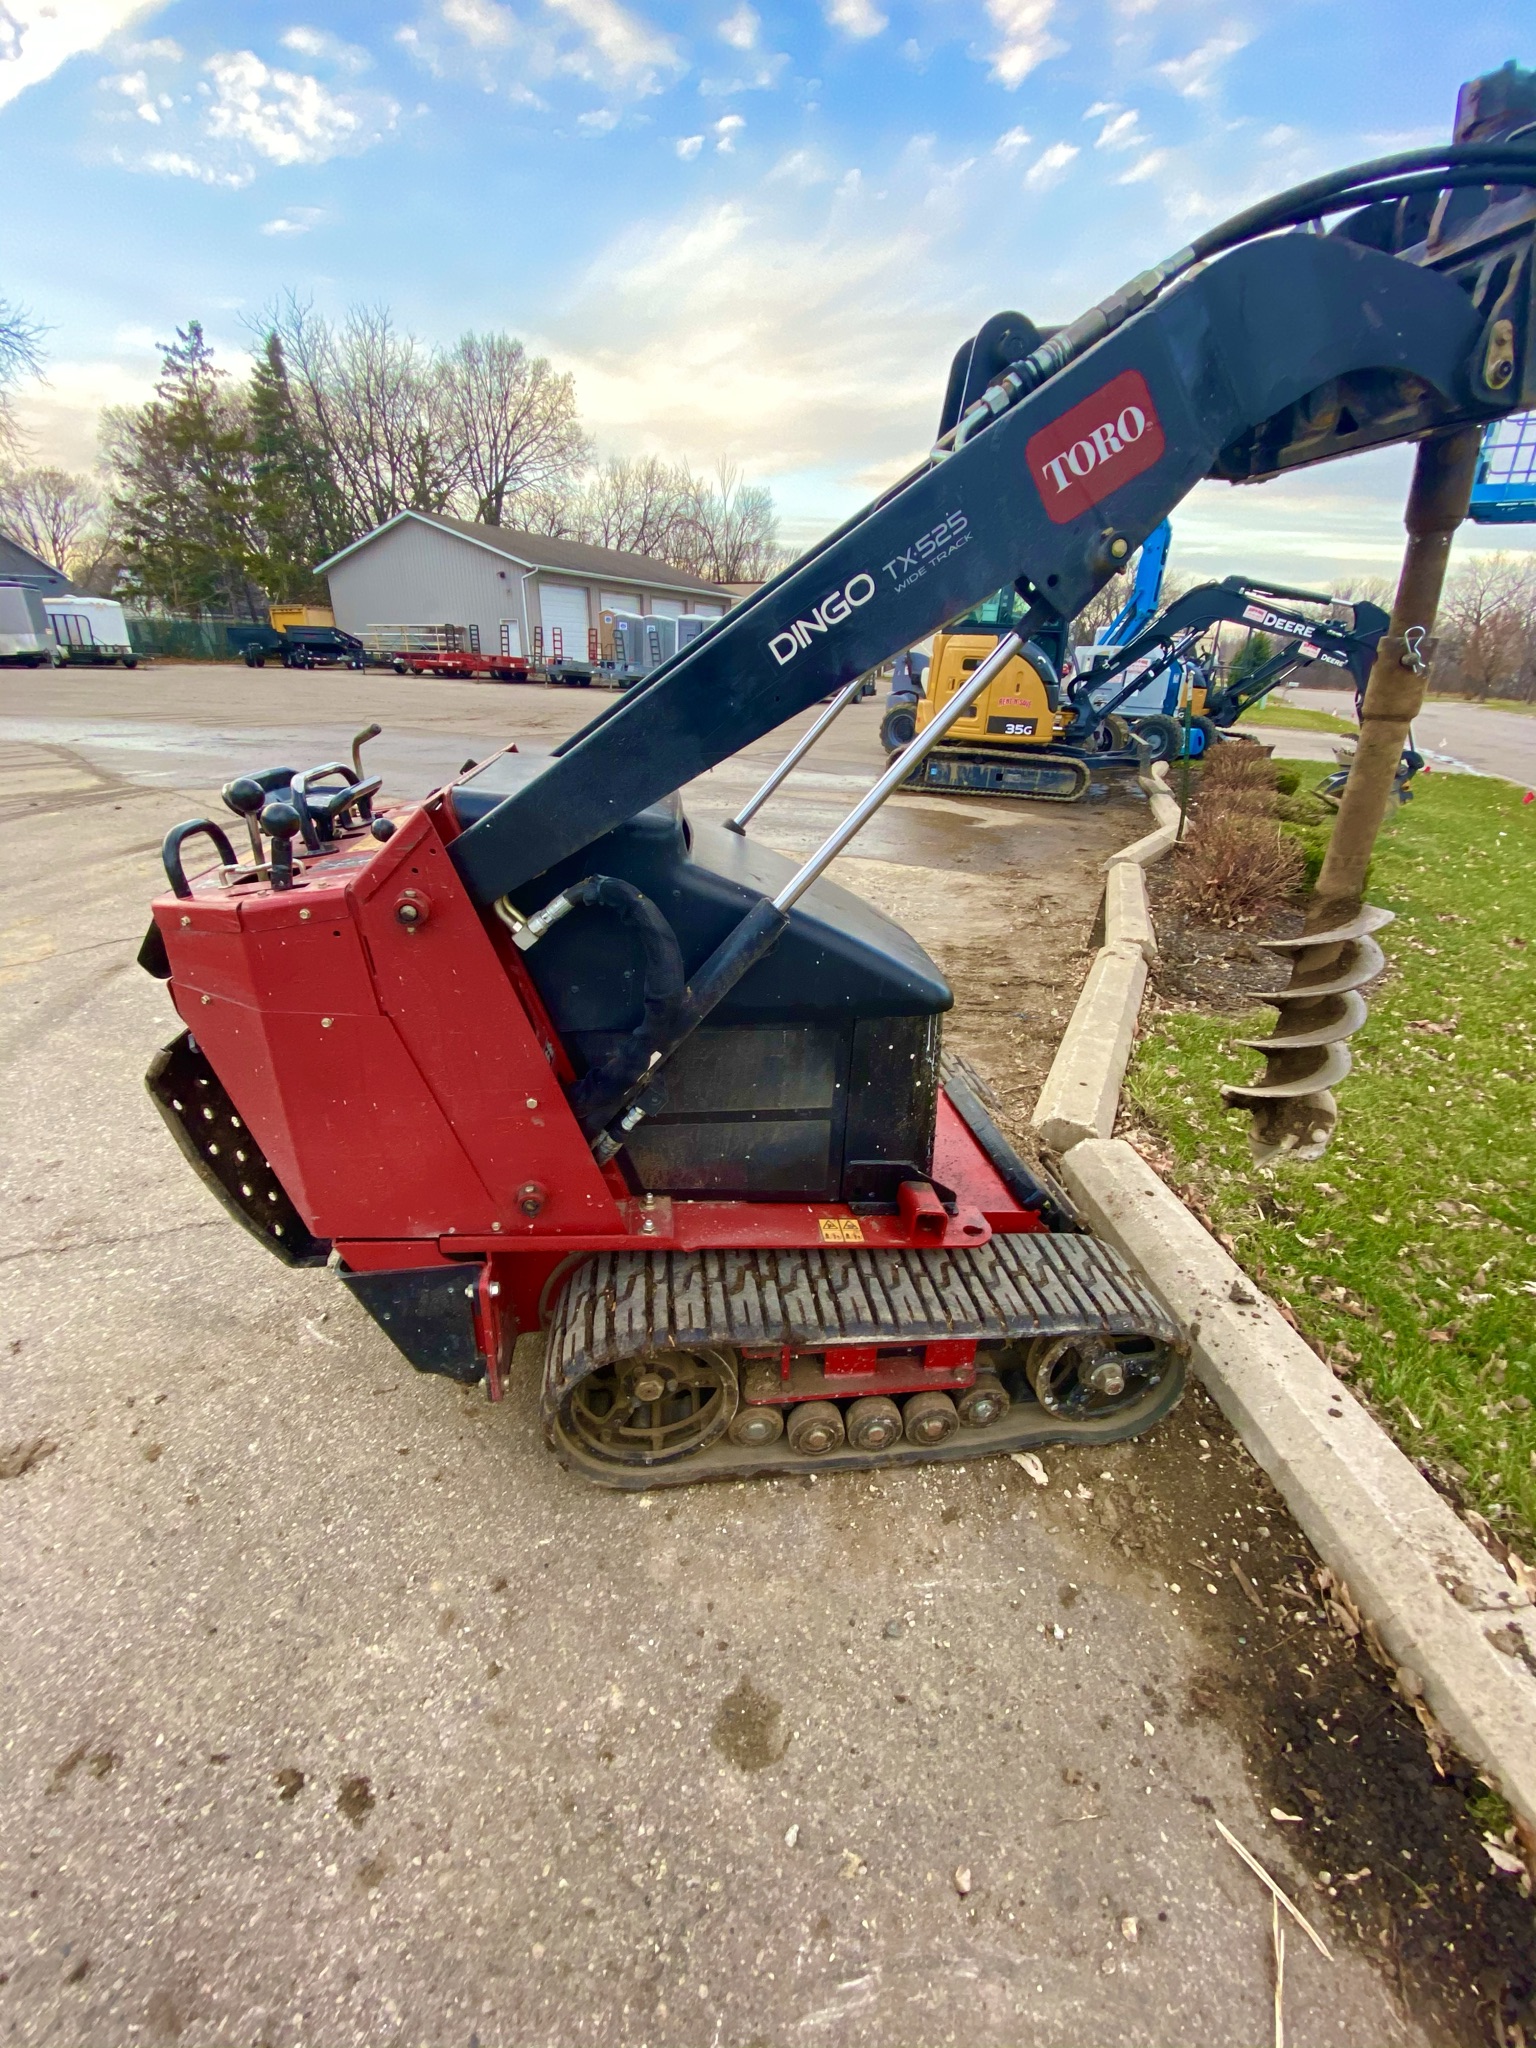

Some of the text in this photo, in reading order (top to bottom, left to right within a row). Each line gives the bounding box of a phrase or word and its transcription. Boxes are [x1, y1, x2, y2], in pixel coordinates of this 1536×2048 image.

[1041, 406, 1145, 494] TORO
[894, 531, 974, 593] WIDE TRACK
[767, 573, 875, 666] DINGO
[1263, 612, 1316, 638] DEERE
[1320, 653, 1345, 667] DEERE
[1004, 723, 1033, 735] 35G
